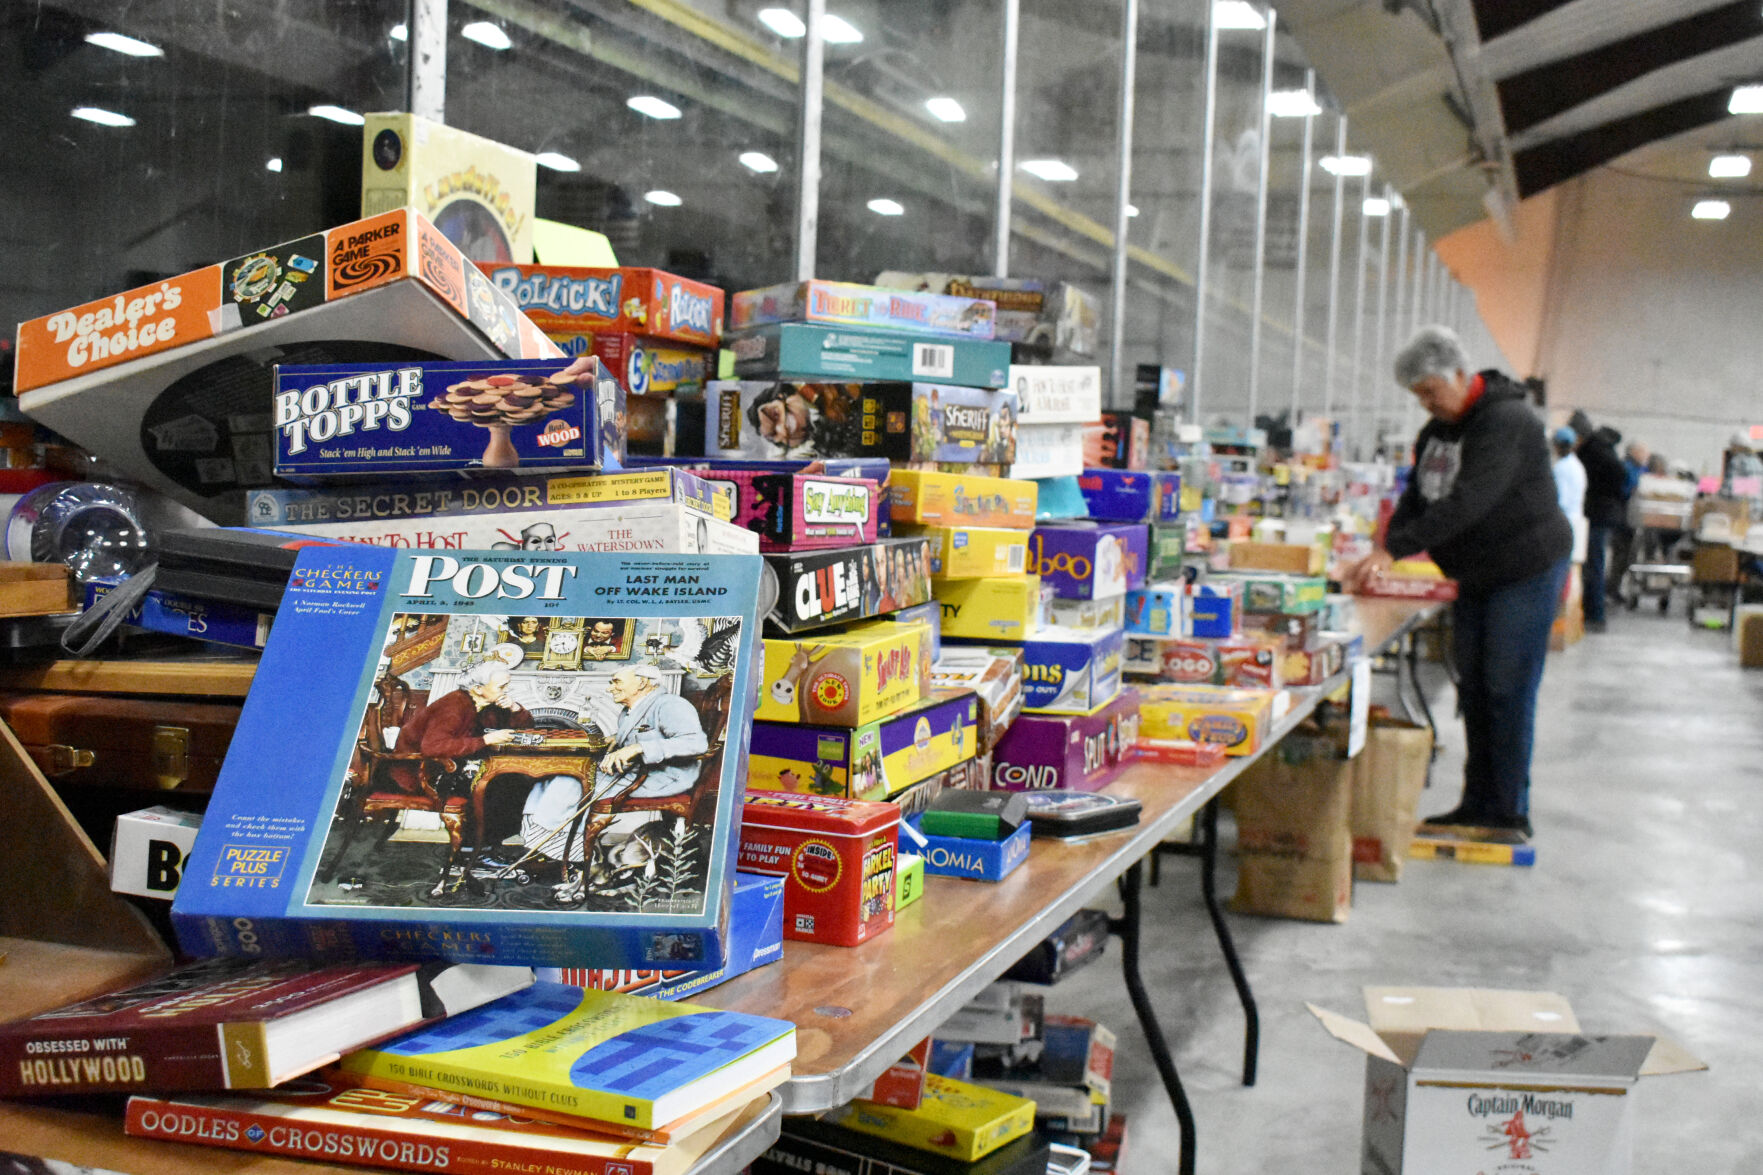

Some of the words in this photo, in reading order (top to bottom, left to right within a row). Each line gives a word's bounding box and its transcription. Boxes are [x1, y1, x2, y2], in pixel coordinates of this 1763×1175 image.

[334, 239, 344, 254] A
[348, 222, 401, 250] PARKER
[333, 245, 371, 267] GAME
[47, 281, 182, 344] Dealer's
[67, 316, 177, 368] Choice
[275, 366, 423, 428] BOTTLE
[284, 396, 412, 456] TOPPS
[537, 427, 581, 447] WOOD
[319, 448, 341, 459] Stack
[342, 448, 357, 458] 'em
[357, 447, 377, 460] High
[377, 447, 393, 457] and
[393, 446, 416, 457] Stack
[417, 445, 431, 456] 'em
[431, 444, 452, 456] Wide
[639, 487, 667, 495] Players
[285, 502, 331, 522] THE
[335, 489, 453, 519] SECRET
[461, 485, 544, 511] DOOR
[608, 529, 633, 540] THE
[577, 538, 665, 552] WATERSDOWN
[295, 568, 383, 581] CHECKERS
[399, 554, 579, 601] POST
[626, 574, 660, 585] LAST
[663, 574, 700, 585] MAN
[305, 578, 365, 591] GAME
[594, 586, 622, 597] OFF
[626, 586, 670, 597] WAKE
[673, 586, 728, 597] ISLAND
[795, 561, 848, 621] CLUE
[267, 823, 287, 832] them
[288, 824, 306, 832] with
[271, 816, 305, 824] mistakes
[231, 830, 245, 838] the
[226, 848, 284, 862] PUZZLE
[743, 841, 774, 854] FAMILY
[774, 845, 792, 856] FUN
[146, 838, 191, 892] B
[230, 861, 269, 874] PLUS
[745, 853, 757, 862] TO
[758, 855, 780, 865] PLAY
[907, 846, 985, 875] NOMIA
[210, 876, 281, 889] SERIES
[659, 987, 676, 999] THE
[676, 969, 724, 993] CODEBREAKER
[26, 1039, 91, 1054] OBSESSED
[20, 1055, 147, 1086] HOLLYWOOD
[388, 1062, 406, 1076] 150
[436, 1071, 500, 1094] CROSSWORDS
[502, 1085, 548, 1102] WITHOUT
[549, 1091, 579, 1108] CLUES
[1467, 1092, 1520, 1119] Captain
[1521, 1092, 1575, 1121] Morgan
[141, 1110, 240, 1142] OODLES
[269, 1125, 450, 1169] CROSSWORDS
[491, 1157, 544, 1175] STANLEY
